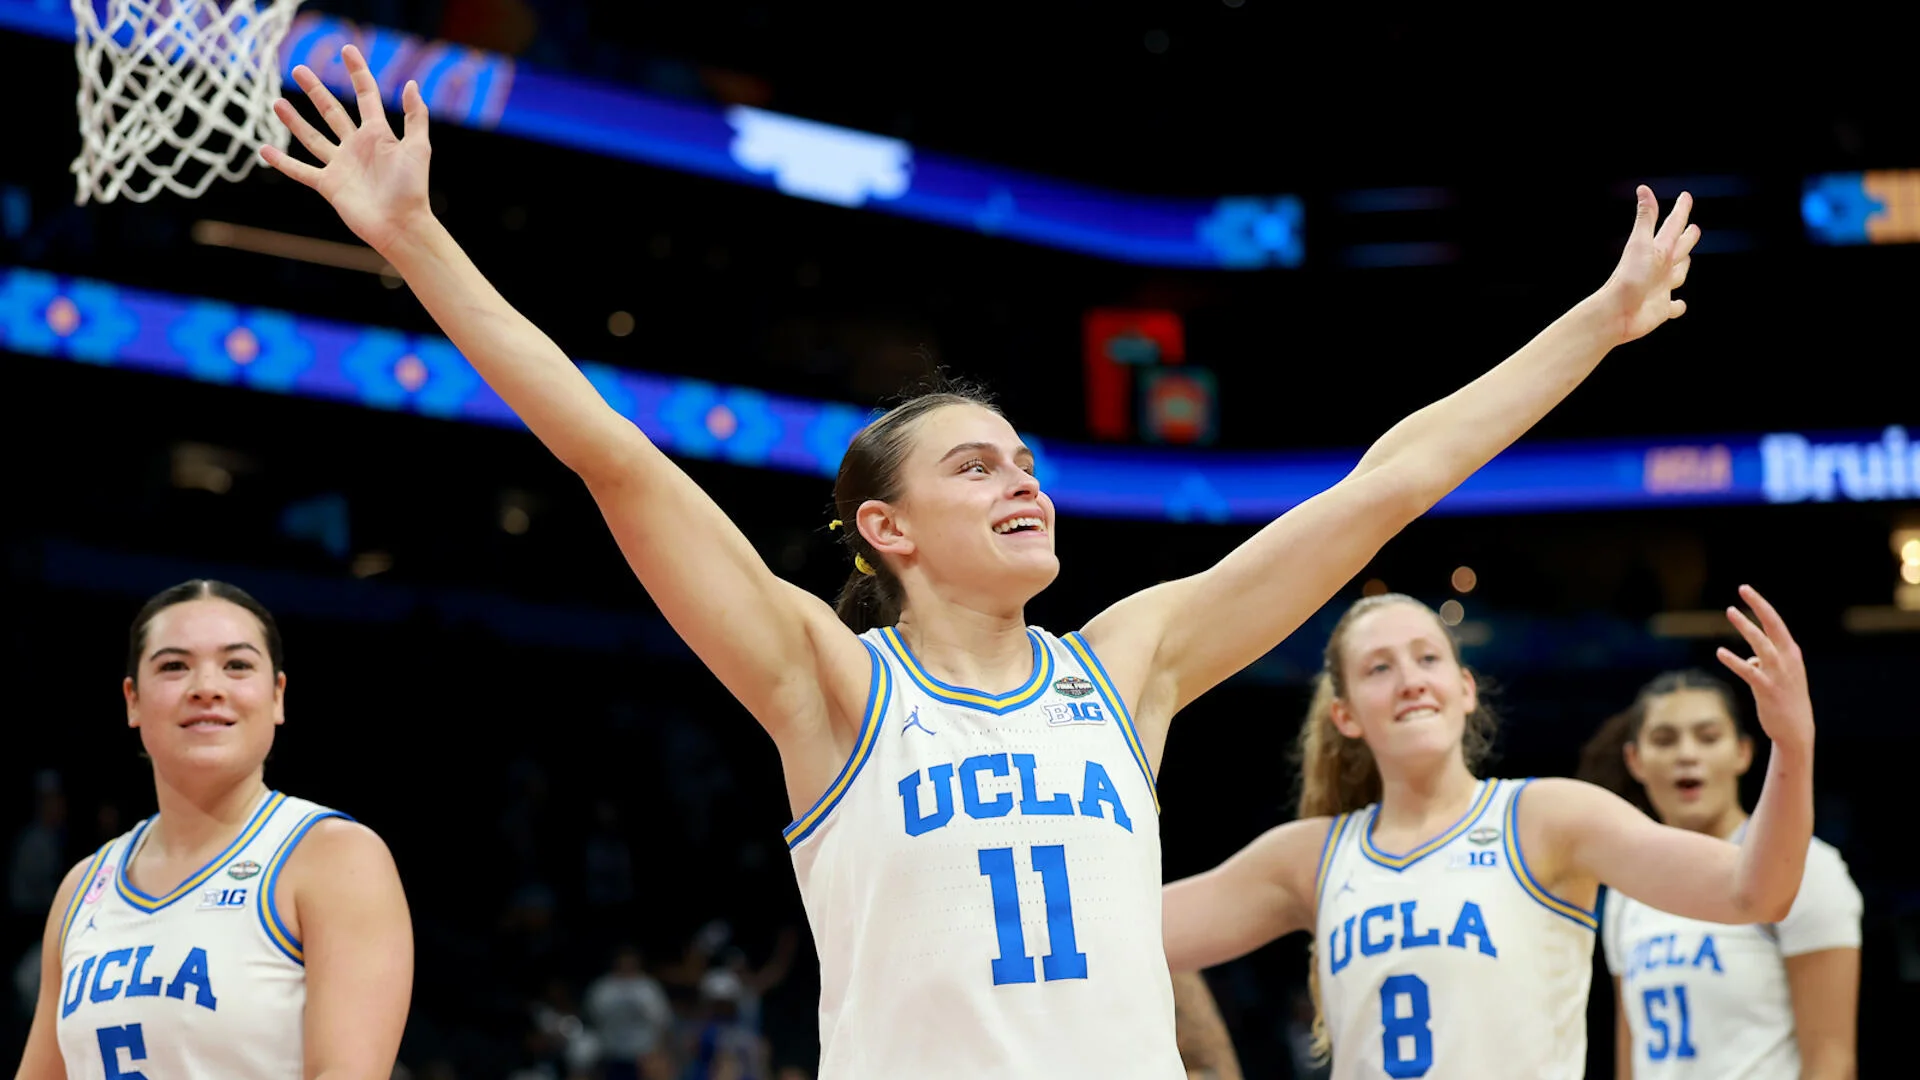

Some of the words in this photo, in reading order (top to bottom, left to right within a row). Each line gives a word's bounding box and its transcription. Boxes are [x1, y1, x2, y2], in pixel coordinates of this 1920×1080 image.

[1760, 426, 1920, 503] Brui
[898, 753, 1133, 837] UCLA
[978, 845, 1088, 985] 11
[1330, 901, 1498, 975] UCLA
[62, 945, 217, 1019] UCLA
[1380, 974, 1433, 1079] 8
[1643, 985, 1696, 1061] 51
